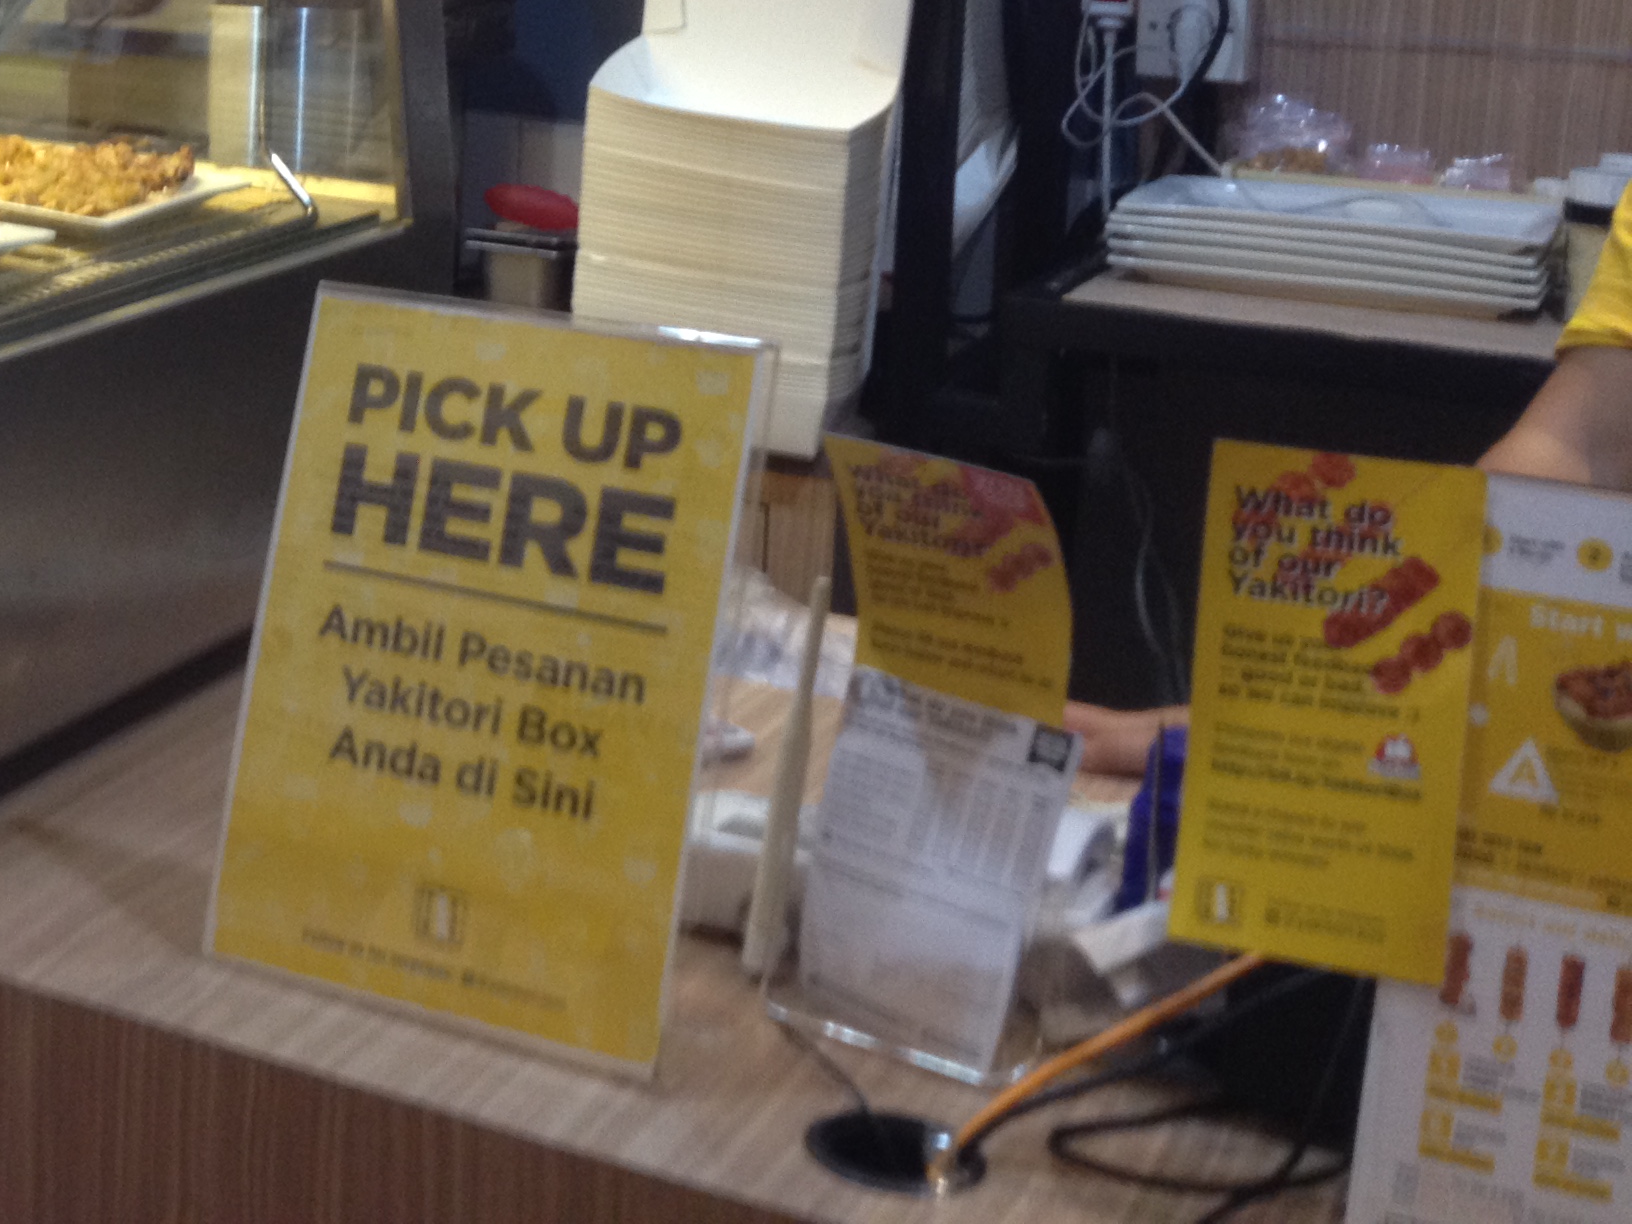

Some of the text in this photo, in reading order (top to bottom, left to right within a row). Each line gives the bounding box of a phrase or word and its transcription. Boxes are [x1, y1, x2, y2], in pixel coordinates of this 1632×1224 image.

[346, 362, 683, 470] PICK UP
[330, 442, 676, 596] HERE
[1234, 484, 1332, 520] What
[319, 604, 647, 705] Ambil Pesanan
[342, 667, 604, 758] Yakitori Box
[329, 726, 597, 821] Anda di Sini
